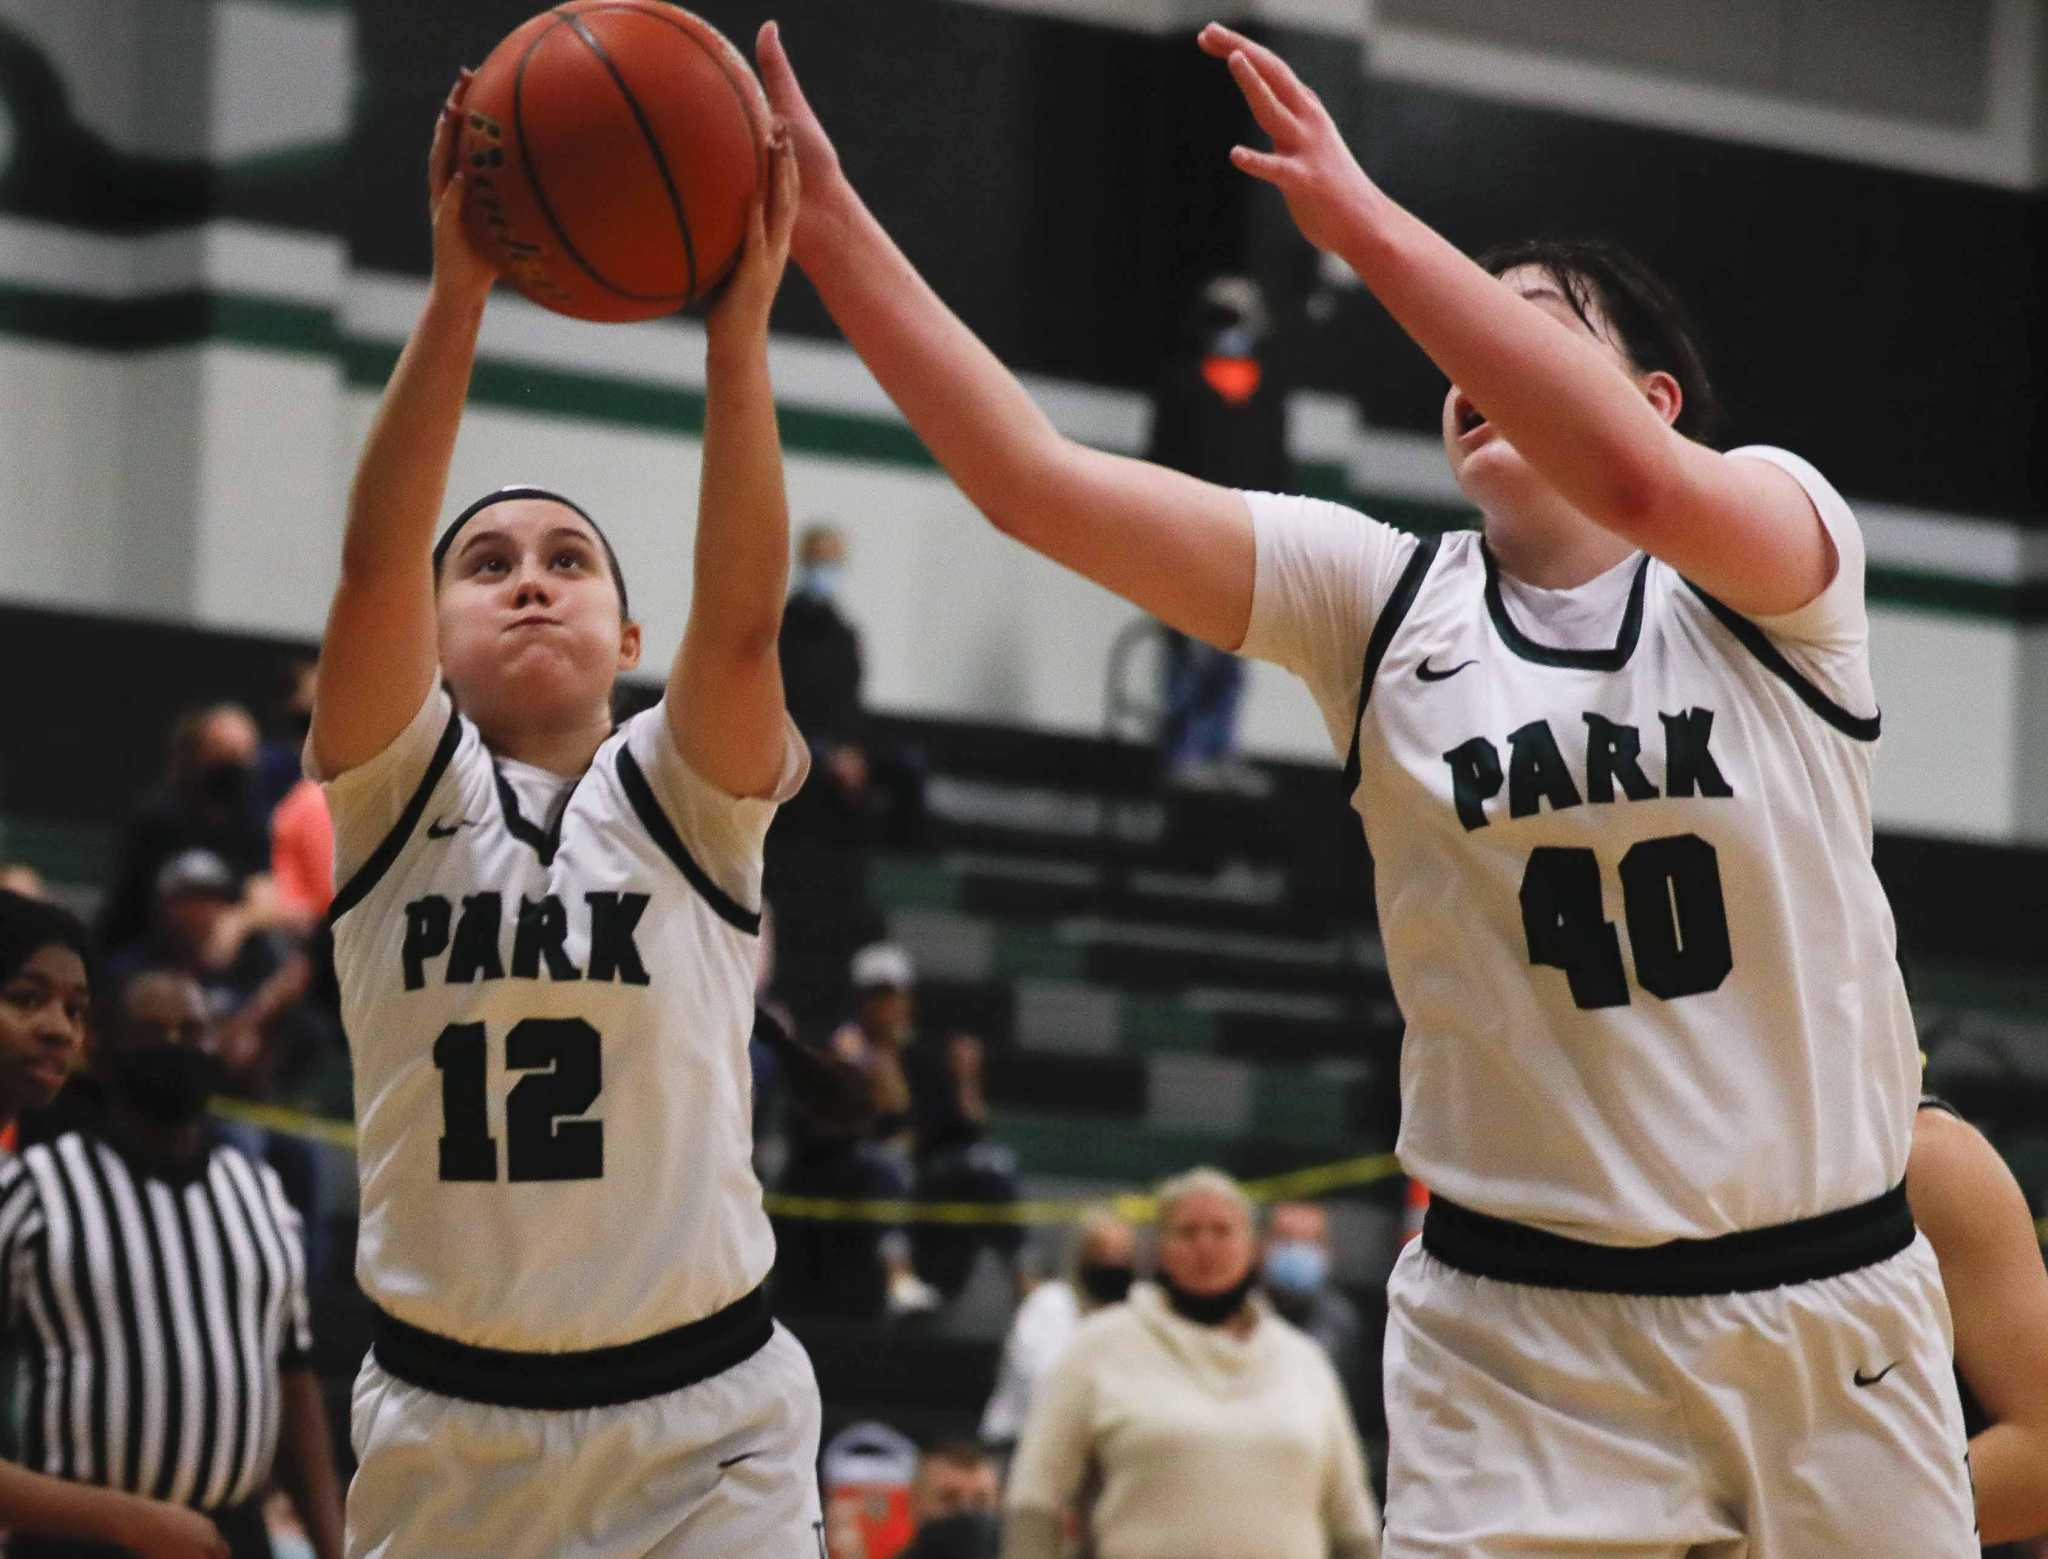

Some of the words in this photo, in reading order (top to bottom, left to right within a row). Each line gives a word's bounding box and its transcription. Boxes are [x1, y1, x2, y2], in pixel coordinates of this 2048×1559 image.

[1443, 707, 1734, 832] PARK
[402, 891, 650, 992] PARK
[1519, 833, 1734, 1009] 40
[433, 1018, 604, 1183] 12
